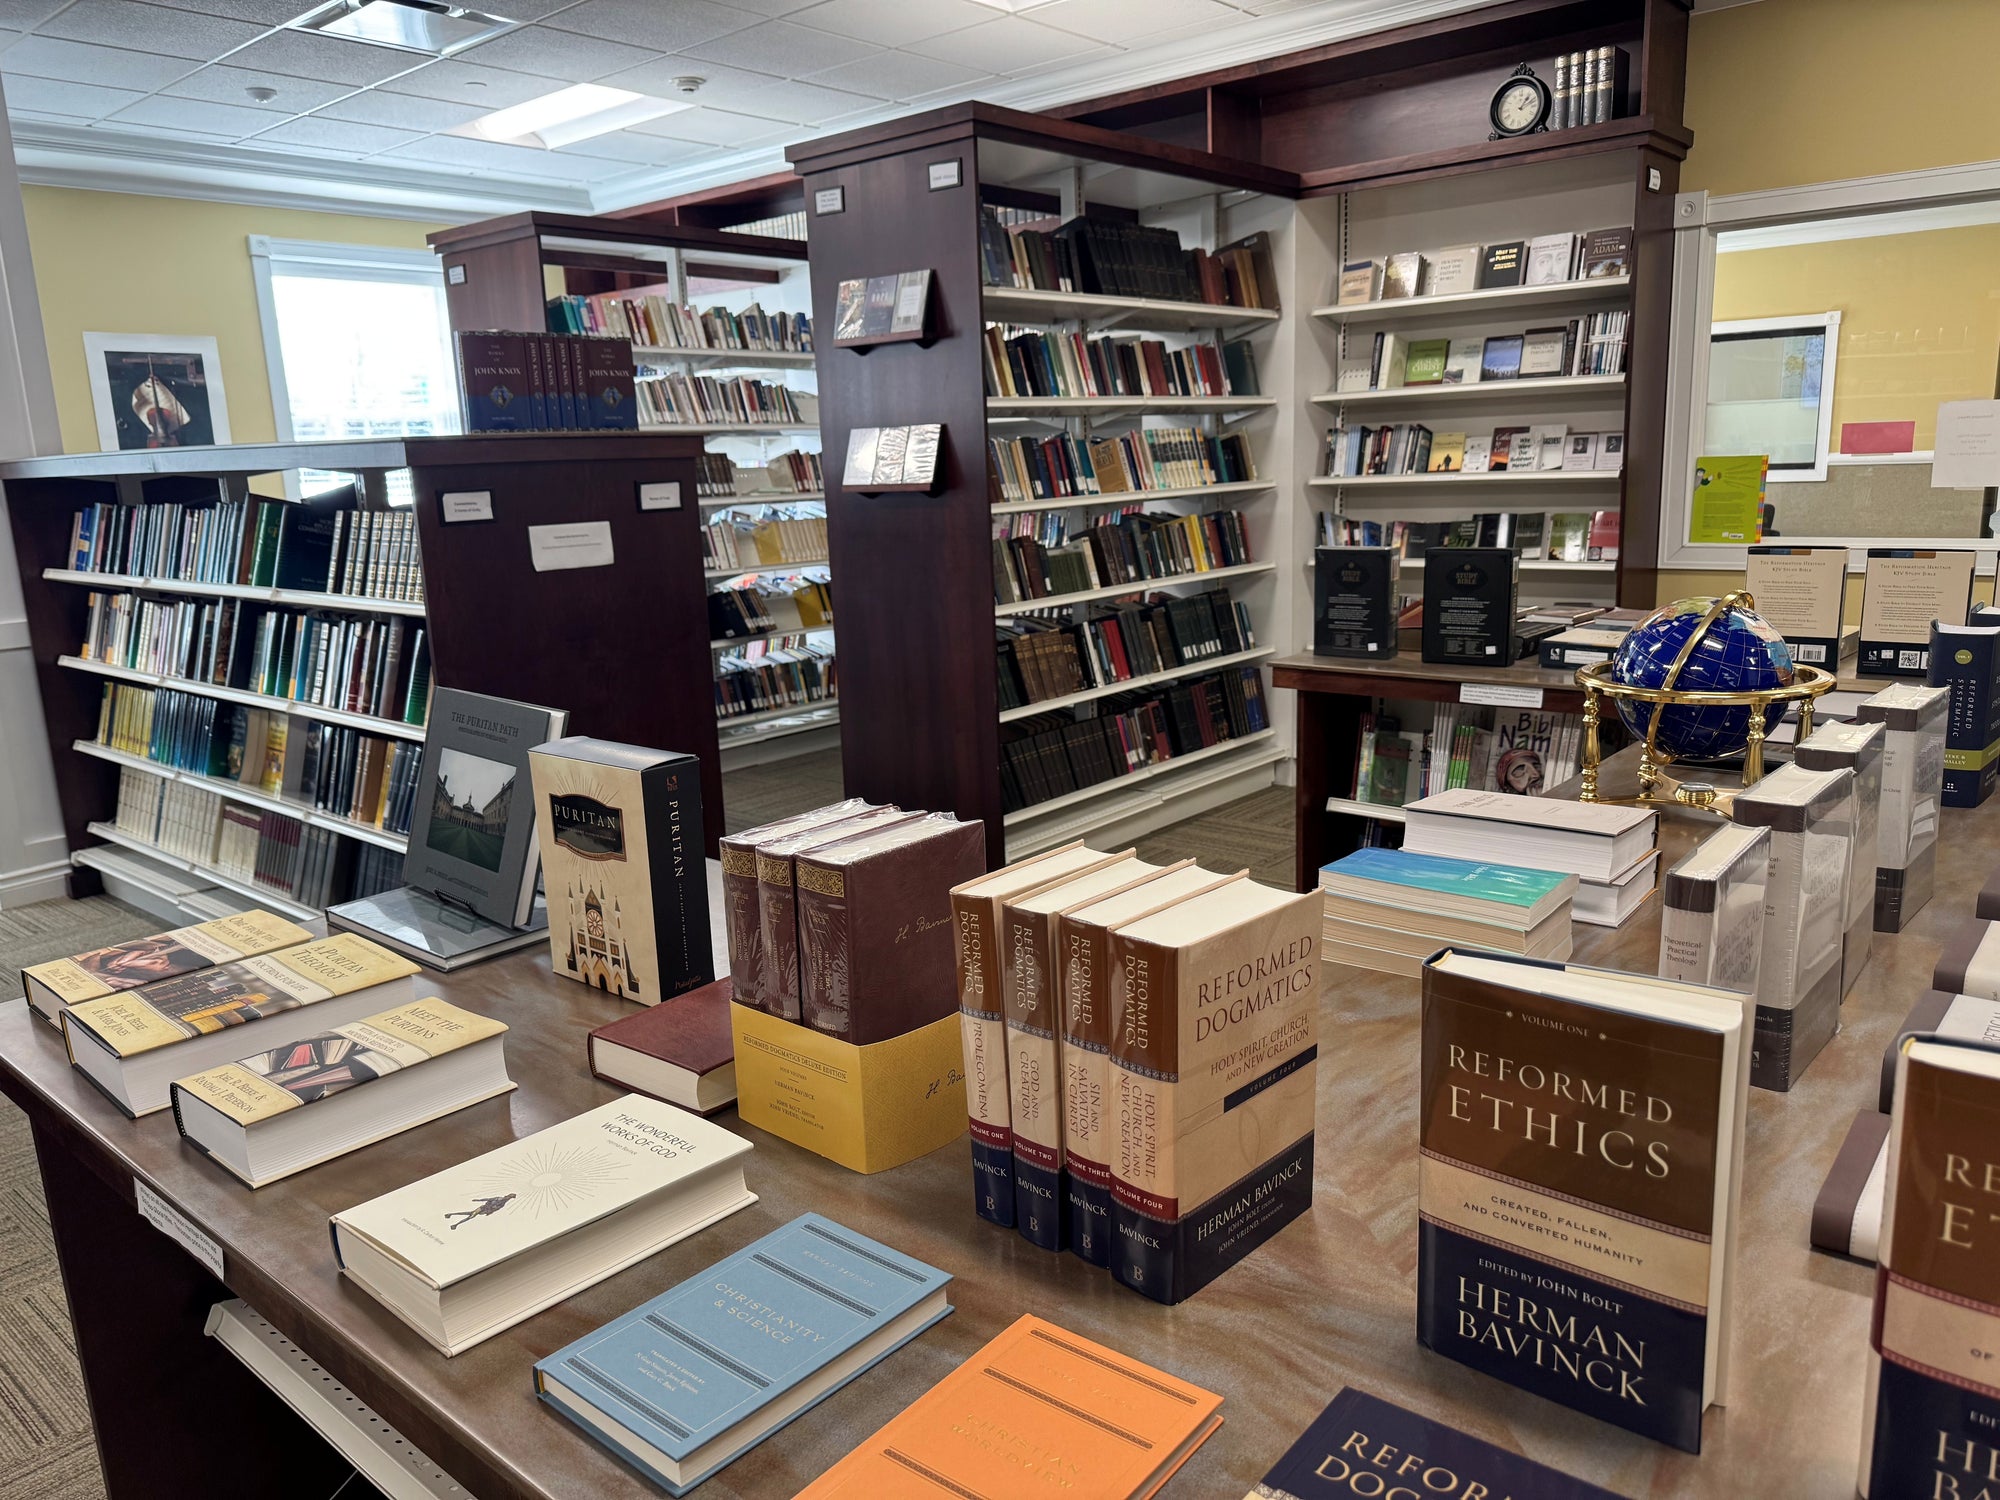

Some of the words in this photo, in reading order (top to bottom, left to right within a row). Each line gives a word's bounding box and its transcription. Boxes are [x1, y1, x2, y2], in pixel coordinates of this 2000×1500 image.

[1593, 245, 1619, 254] ADAM
[474, 367, 497, 376] JOHN
[498, 367, 521, 376] KNOX
[588, 369, 608, 378] JOHN
[1953, 678, 1964, 737] SYSTEMATIC
[1966, 680, 1976, 729] REFORMED
[452, 712, 465, 723] THE
[466, 715, 499, 732] PURITAN
[500, 724, 519, 738] PATH
[1500, 724, 1550, 752] Nam
[554, 804, 616, 829] PURITAN
[669, 800, 684, 878] PURITAN
[960, 911, 974, 993] DOGMATICS
[970, 913, 984, 994] REFORMED
[1664, 936, 1704, 950] Theoretical-
[1667, 946, 1698, 957] Practical
[292, 949, 350, 981] THEOLOGY
[322, 948, 368, 974] PURITAN
[1014, 924, 1026, 1009] DOGMATICS
[1024, 927, 1036, 1012] REFORMED
[1198, 936, 1313, 1008] REFORMED
[1666, 954, 1698, 967] Theology
[1070, 934, 1082, 1022] DOGMATICS
[1081, 938, 1092, 1025] REFORMED
[1126, 954, 1136, 1047] DOGMATICS
[1138, 959, 1148, 1050] REFORMED
[1196, 964, 1313, 1044] DOGMATICS
[384, 1016, 440, 1040] PURITANS
[405, 1006, 440, 1022] MEET
[438, 1018, 464, 1033] THE
[1520, 1013, 1565, 1032] VOLUME
[1567, 1024, 1590, 1038] ONE
[744, 1036, 768, 1050] REFORMED
[770, 1046, 800, 1062] DOGMATICS
[802, 1058, 822, 1071] DELUXE
[822, 1065, 846, 1079] EDITION
[974, 1022, 988, 1119] PROLEGOMENA
[1068, 1062, 1079, 1079] IN
[1210, 1052, 1238, 1076] HOLY
[1226, 1066, 1242, 1083] AND
[1243, 1050, 1267, 1075] NEW
[1267, 1026, 1310, 1058] CREATION
[1020, 1050, 1031, 1120] CREATION
[1030, 1059, 1040, 1091] GOD
[1120, 1072, 1132, 1105] NEW
[1249, 1072, 1278, 1094] VOLUME
[1280, 1061, 1297, 1076] FOUR
[1449, 1044, 1673, 1124] REFORMED
[1031, 1096, 1039, 1120] AND
[1069, 1083, 1079, 1137] CHRIST
[1078, 1066, 1089, 1141] SALVATION
[1090, 1084, 1100, 1108] SIN
[1144, 1092, 1156, 1130] HOLY
[614, 1113, 638, 1126] THE
[634, 1122, 697, 1154] WONDERFUL
[971, 1124, 990, 1136] VOLUME
[990, 1130, 1004, 1140] ONE
[1090, 1109, 1100, 1133] AND
[1448, 1084, 1670, 1178] ETHICS
[600, 1122, 639, 1141] WORKS
[634, 1137, 654, 1148] OF
[650, 1144, 677, 1159] GOD
[1014, 1140, 1036, 1156] VOLUME
[1038, 1151, 1052, 1161] TWO
[1120, 1108, 1132, 1179] CREATION
[974, 1158, 1007, 1178] BAVINCK
[1088, 1166, 1110, 1178] THREE
[1132, 1152, 1141, 1177] AND
[986, 1195, 995, 1210] B
[1017, 1176, 1052, 1199] BAVINCK
[1115, 1184, 1142, 1204] VOLUME
[1143, 1198, 1164, 1211] FOUR
[1197, 1193, 1252, 1242] HERMAN
[1254, 1157, 1303, 1202] BAVINCK
[1070, 1193, 1108, 1217] BAVINCK
[1492, 1195, 1552, 1222] CREATED,
[1557, 1216, 1613, 1242] FALLEN,
[1029, 1216, 1039, 1232] B
[1119, 1223, 1160, 1250] BAVINCK
[1228, 1216, 1245, 1235] JOHN
[1463, 1201, 1488, 1216] AND
[1492, 1210, 1569, 1242] CONVERTED
[1574, 1238, 1644, 1266] HUMANITY
[1082, 1233, 1092, 1250] B
[1218, 1238, 1235, 1255] JOHN
[1134, 1264, 1144, 1282] B
[1478, 1258, 1519, 1278] EDITED
[1520, 1272, 1534, 1284] BY
[1536, 1276, 1580, 1300] JOHN
[1582, 1291, 1624, 1315] BOLT
[714, 1282, 826, 1344] CHRISTIANITY
[714, 1299, 724, 1309] &
[727, 1306, 796, 1346] SCIENCE
[1457, 1274, 1648, 1370] HERMAN
[1457, 1309, 1649, 1407] BAVINCK
[1970, 1348, 1995, 1360] OF
[952, 1424, 1074, 1489] WORLDVIEW
[967, 1413, 1081, 1474] CHRISTIAN
